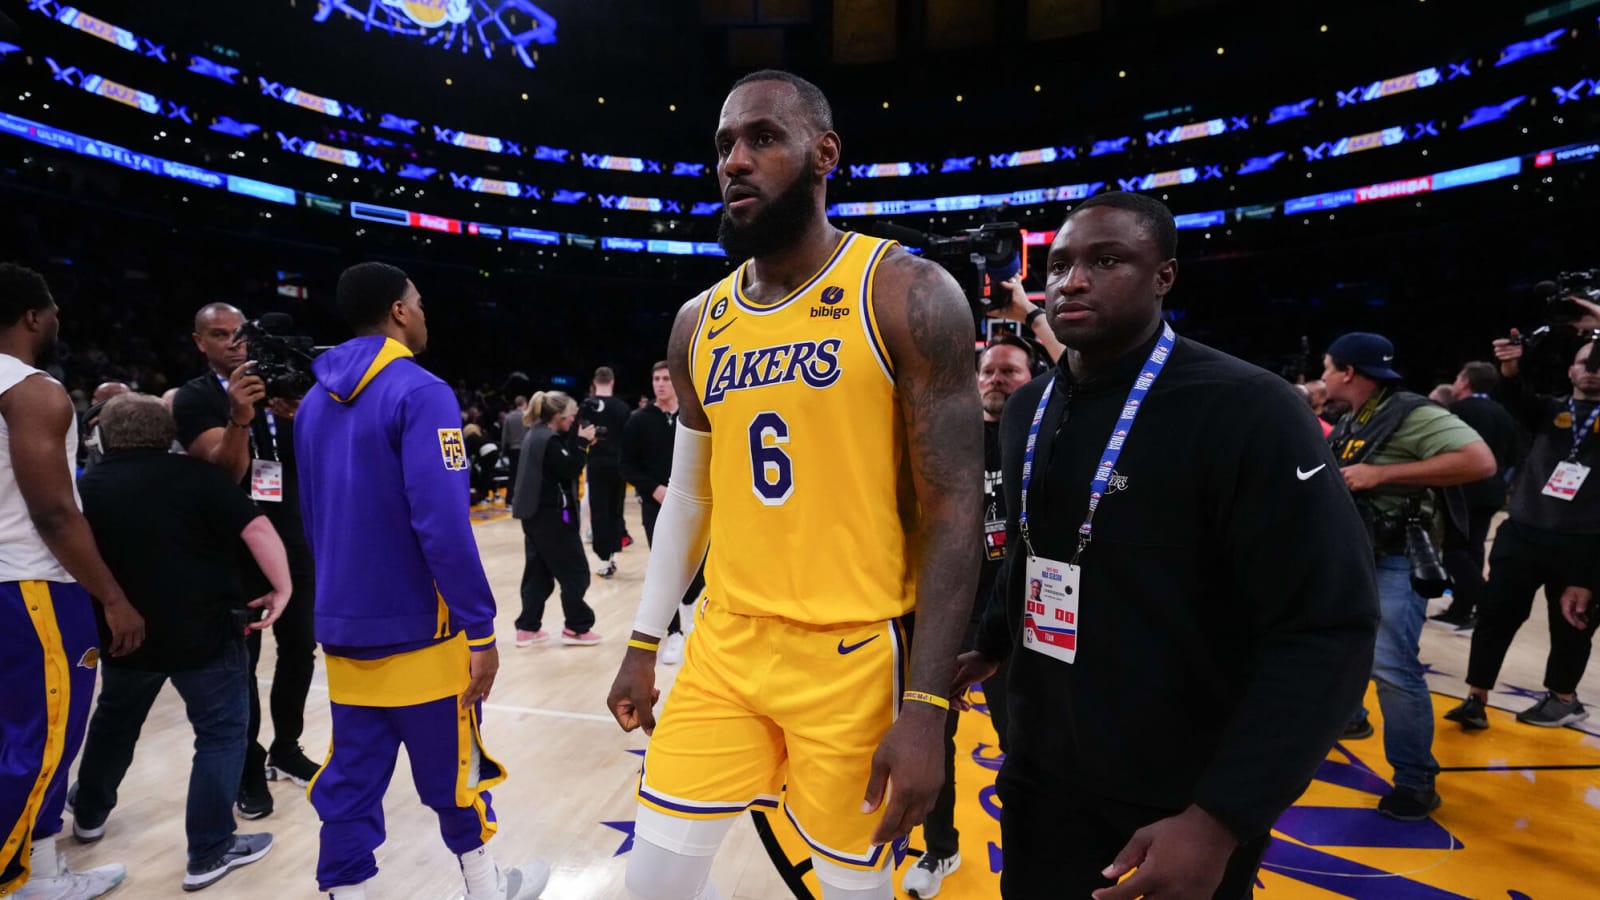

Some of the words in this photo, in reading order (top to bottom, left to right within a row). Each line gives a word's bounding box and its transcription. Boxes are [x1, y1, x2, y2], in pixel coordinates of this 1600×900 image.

[101, 146, 152, 169] DELTA
[1357, 178, 1429, 201] TOSHIBA
[810, 306, 850, 319] bibigo
[702, 338, 843, 406] LAKERS
[1108, 435, 1124, 450] NBA
[747, 410, 795, 506] 6
[1095, 466, 1111, 481] NBA
